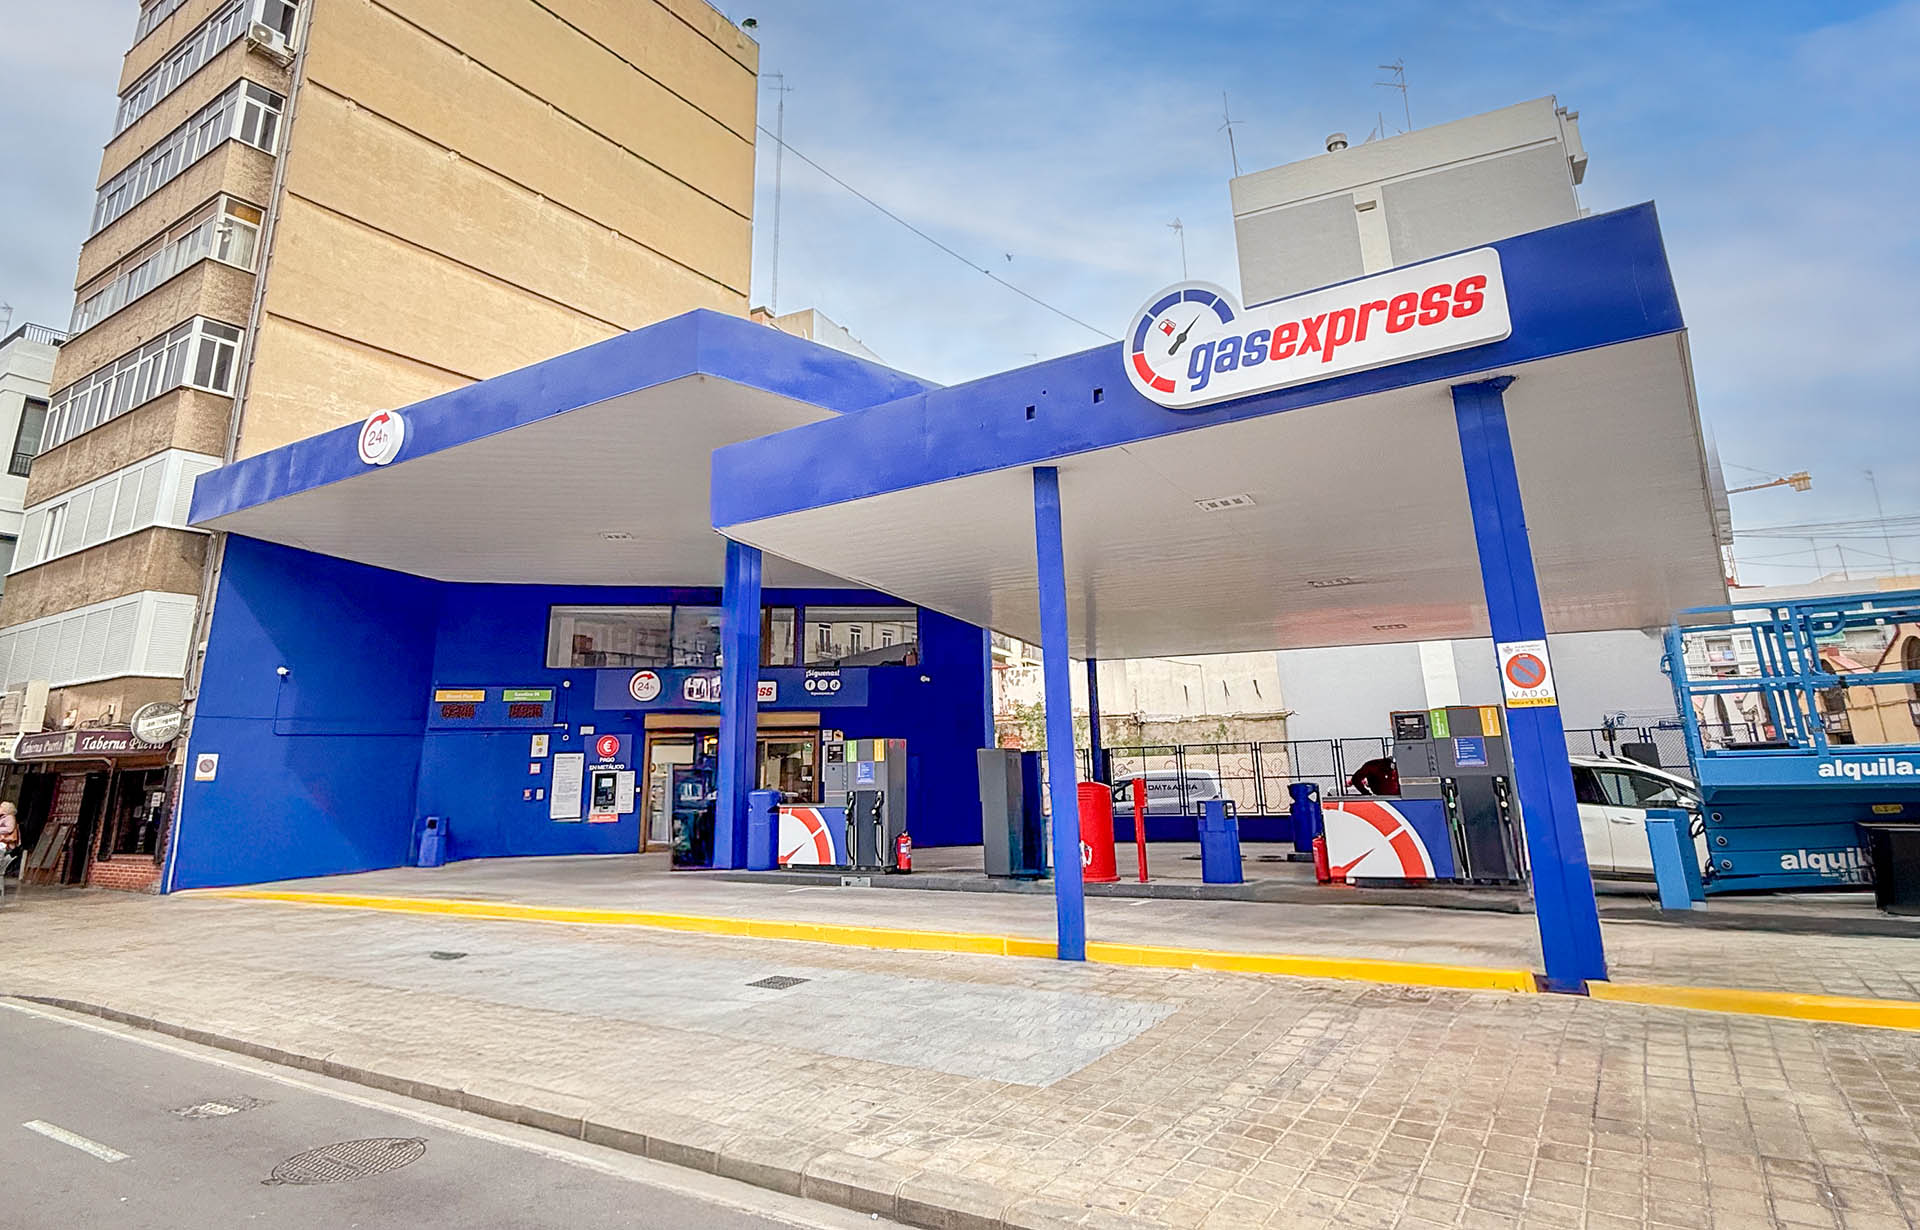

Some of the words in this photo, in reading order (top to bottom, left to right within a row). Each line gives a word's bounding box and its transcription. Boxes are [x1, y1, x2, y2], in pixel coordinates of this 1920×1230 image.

[1187, 274, 1487, 392] gasexpress
[367, 428, 389, 446] 24h
[1511, 689, 1549, 698] VADO
[82, 735, 127, 750] Taberna
